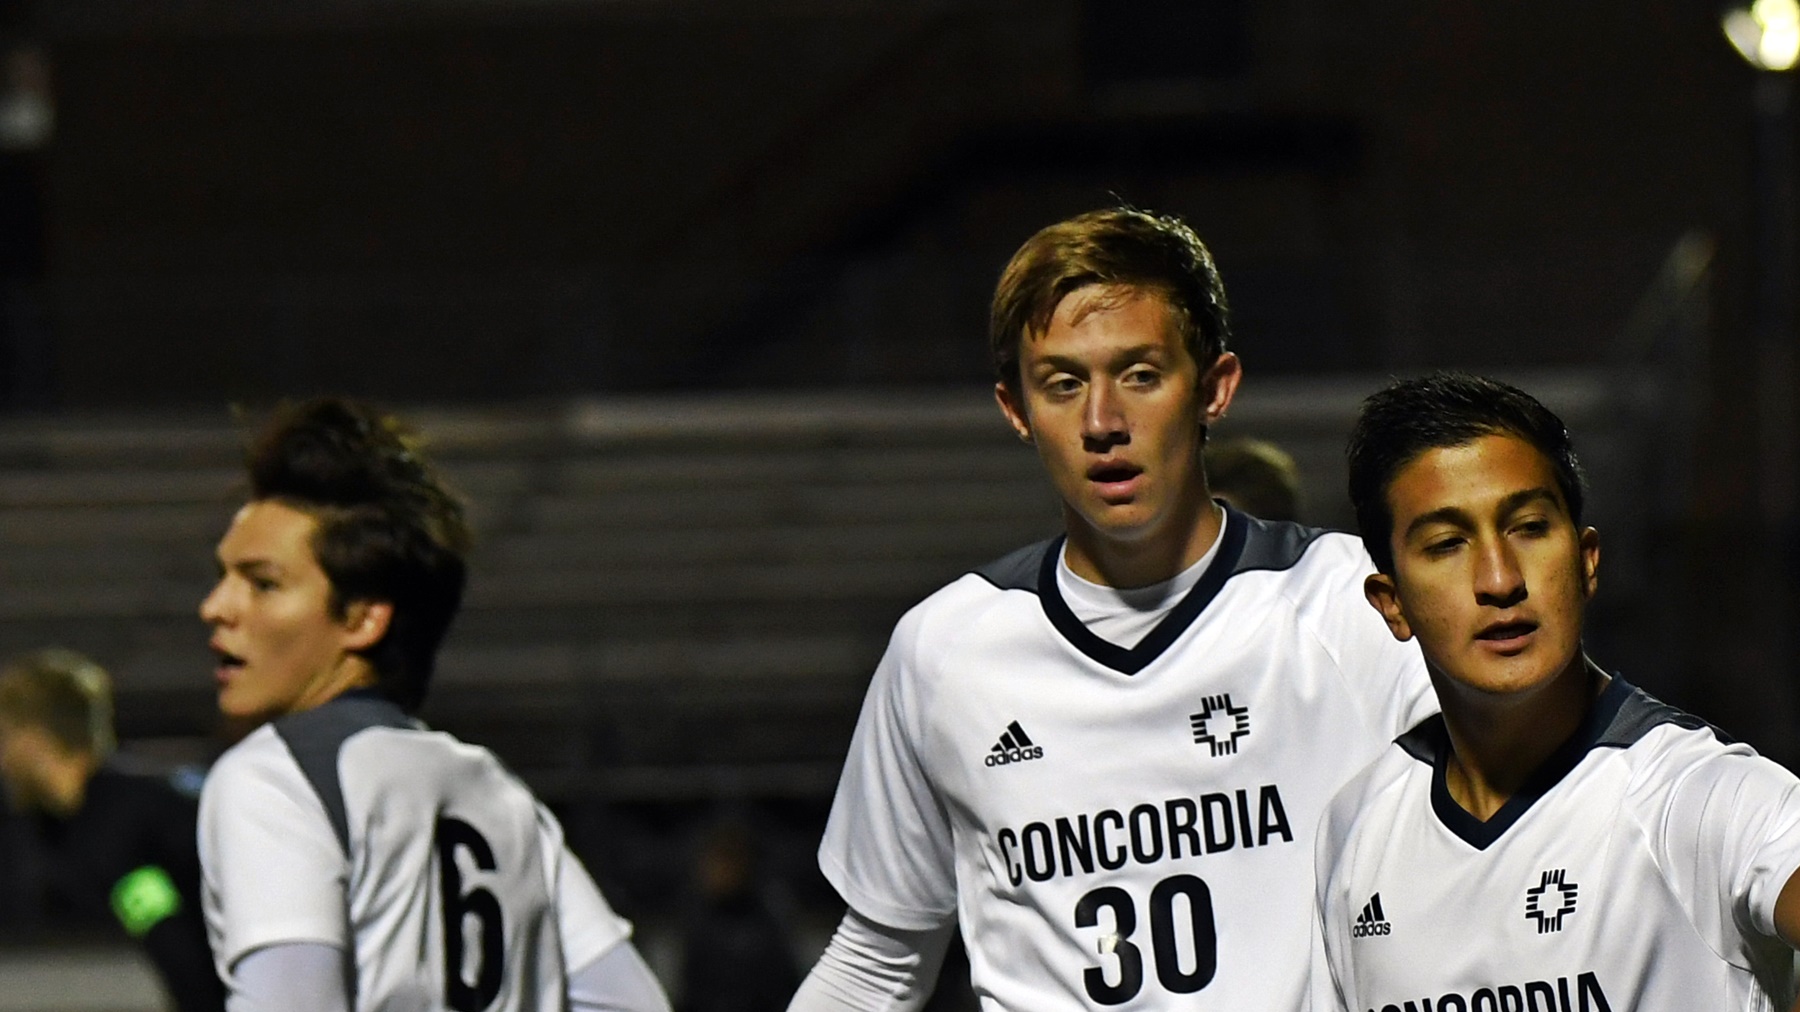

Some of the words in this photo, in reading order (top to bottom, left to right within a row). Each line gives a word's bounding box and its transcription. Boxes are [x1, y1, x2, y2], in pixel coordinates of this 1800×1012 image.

[985, 746, 1044, 767] adidas
[997, 784, 1294, 887] CONCORDIA
[1075, 874, 1217, 1005] 30
[1353, 922, 1391, 938] adidas
